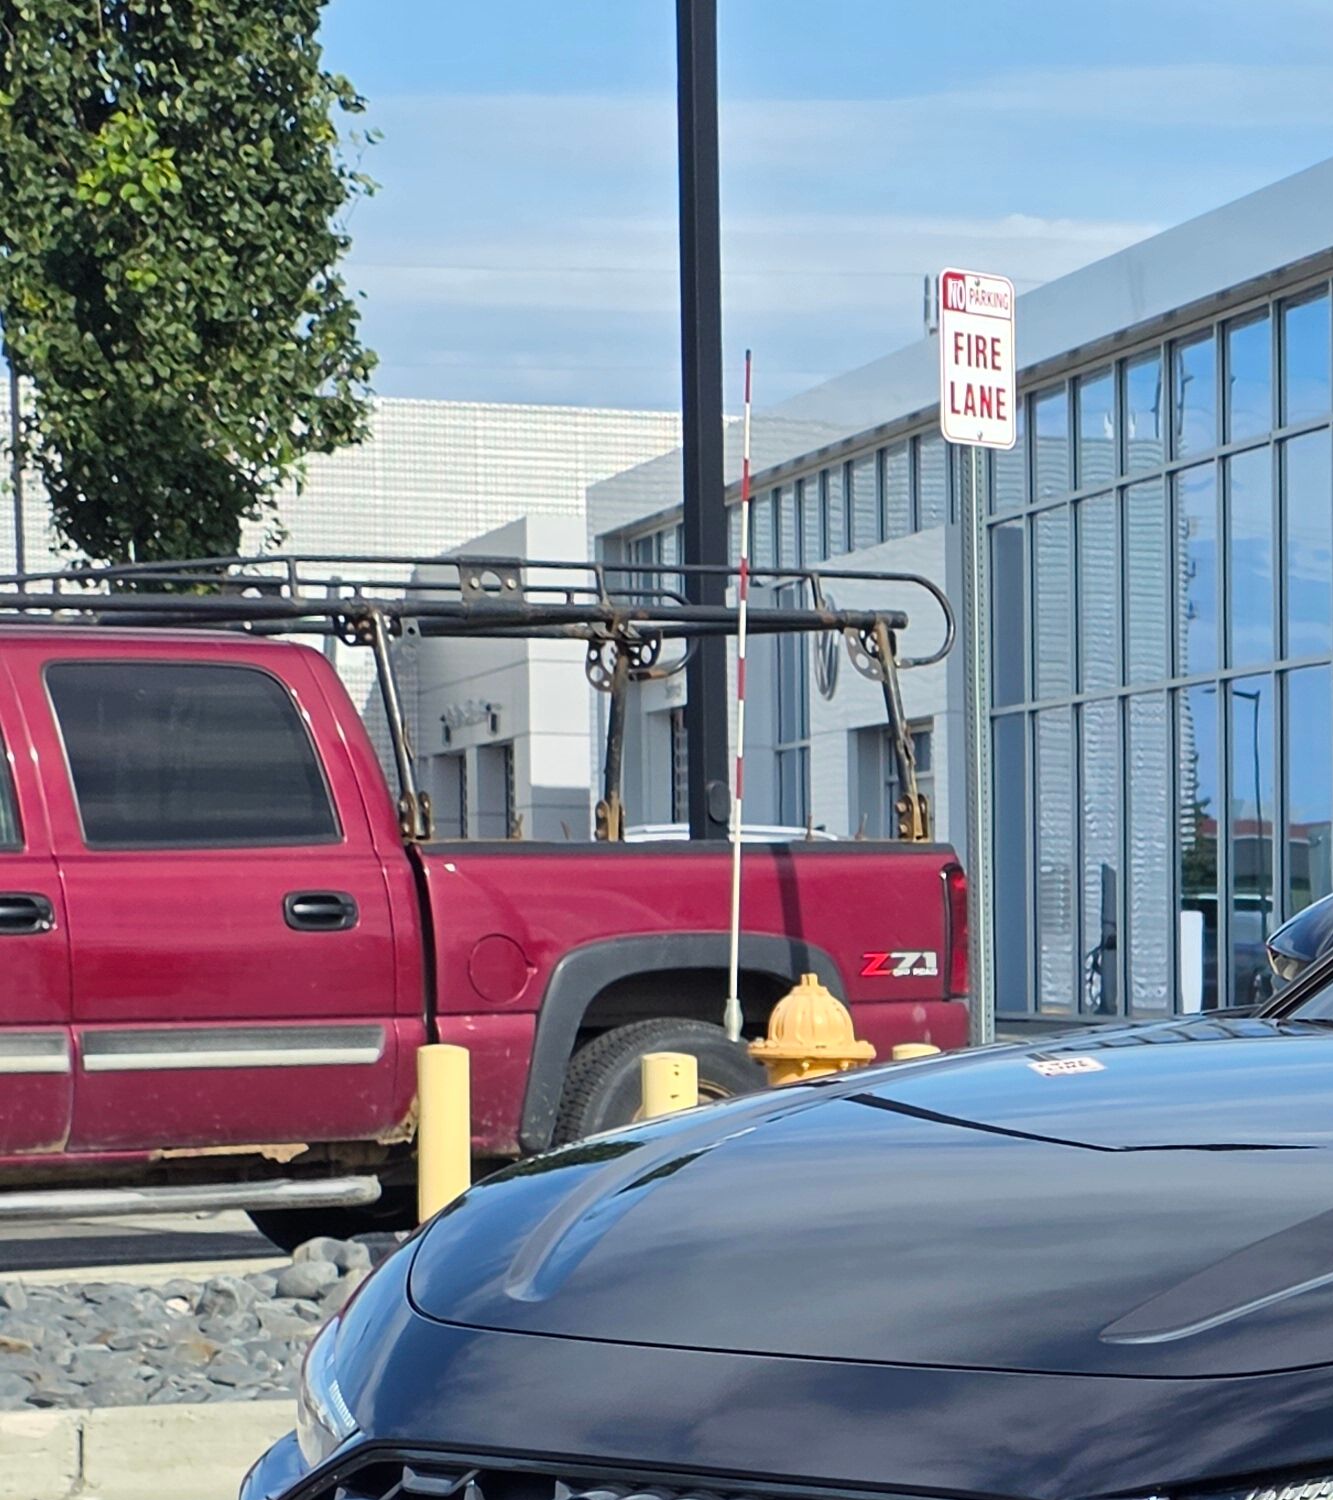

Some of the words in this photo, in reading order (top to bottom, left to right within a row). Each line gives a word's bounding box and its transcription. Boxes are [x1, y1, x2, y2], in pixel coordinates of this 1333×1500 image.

[948, 278, 966, 309] NO
[969, 287, 1009, 310] PARKING
[954, 331, 1002, 371] FIRE
[950, 381, 1007, 421] LANE
[861, 951, 938, 976] Z71
